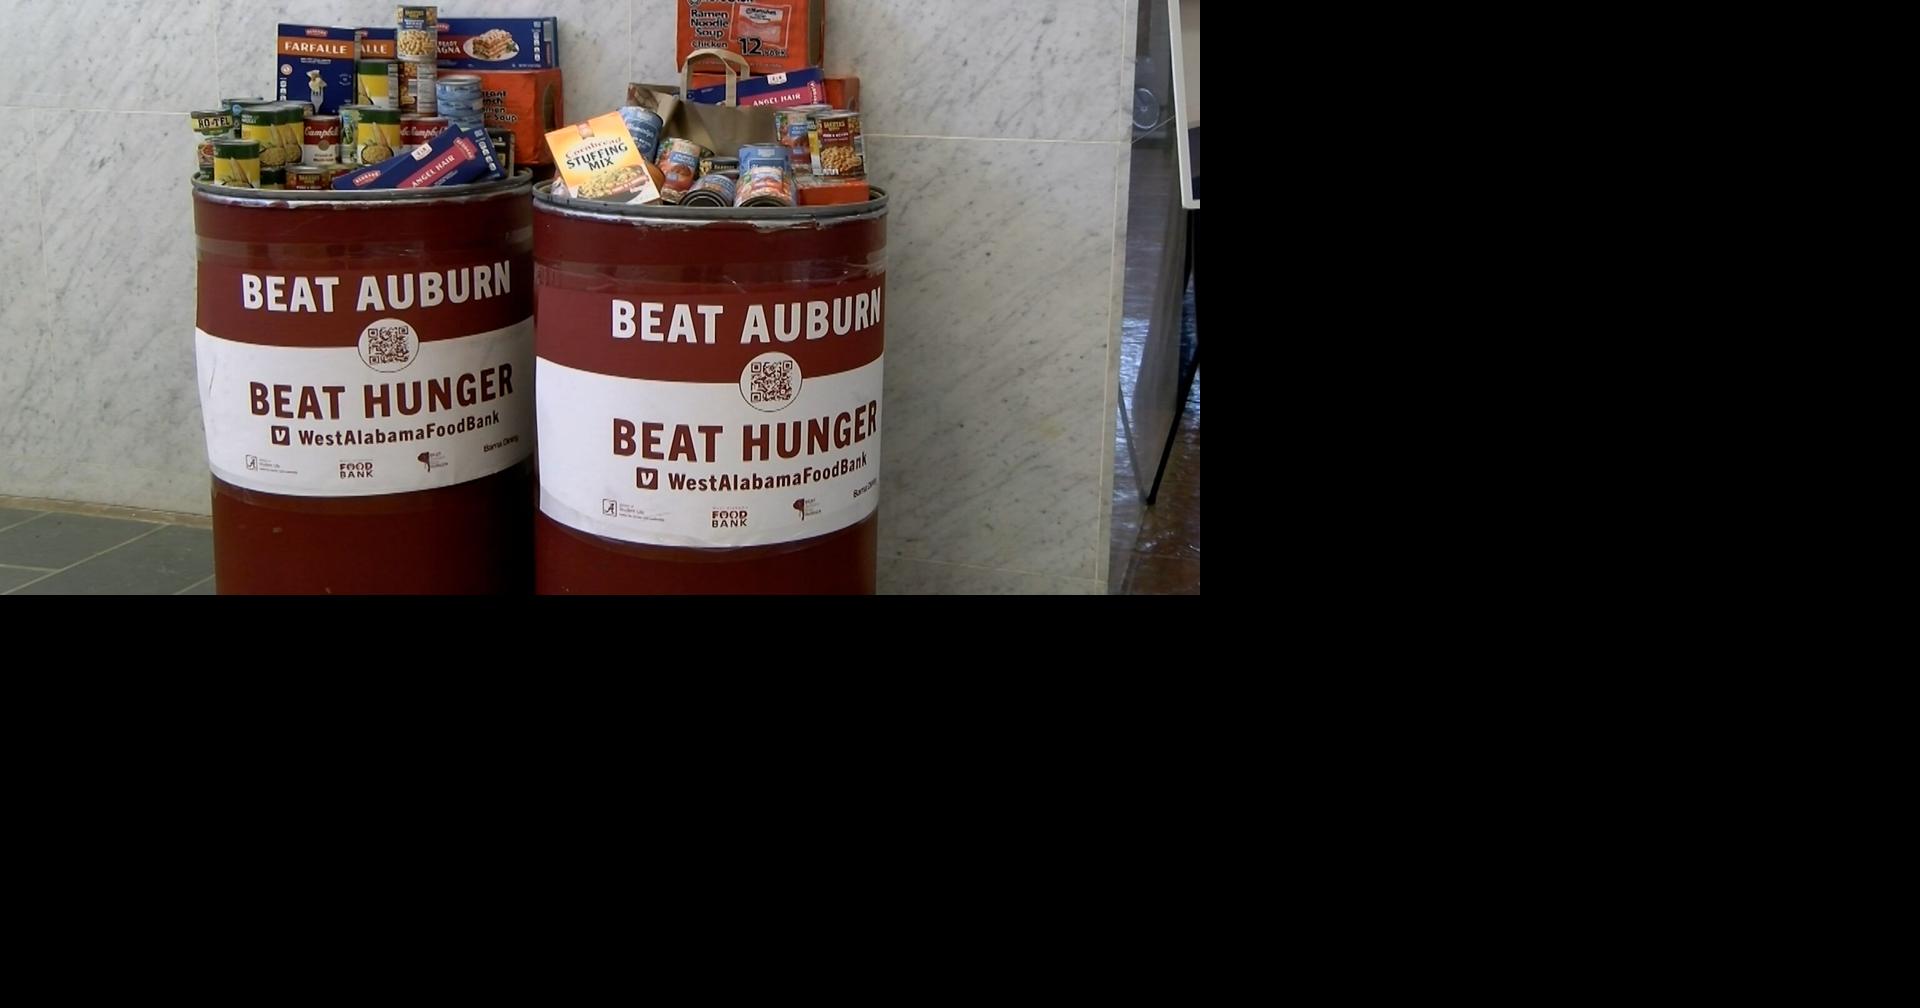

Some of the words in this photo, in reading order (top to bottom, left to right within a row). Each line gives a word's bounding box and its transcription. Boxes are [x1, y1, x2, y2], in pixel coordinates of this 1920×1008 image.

[690, 9, 729, 19] Ramen
[690, 18, 729, 28] Noodle
[696, 27, 724, 38] Soup
[284, 41, 348, 54] FARFALLE
[739, 38, 761, 55] 12
[566, 142, 628, 170] STUFFING
[588, 156, 614, 172] MIX
[411, 169, 437, 188] ANGEL
[435, 154, 456, 171] HAIR
[241, 273, 340, 313] BEAT
[356, 260, 511, 312] AUBURN
[611, 299, 724, 344] BEAT
[740, 286, 881, 344] AUBURN
[249, 380, 346, 420] BEAT
[363, 362, 514, 419] HUNGER
[298, 410, 500, 447] WestAlabamaFoodBank
[612, 417, 724, 463] BEAT
[742, 399, 878, 462] HUNGER
[339, 462, 374, 471] FOOD
[339, 470, 374, 479] BANK
[668, 451, 868, 492] WestAlabamaFoodBank
[711, 510, 748, 519] FOOD
[711, 519, 748, 528] BANK
